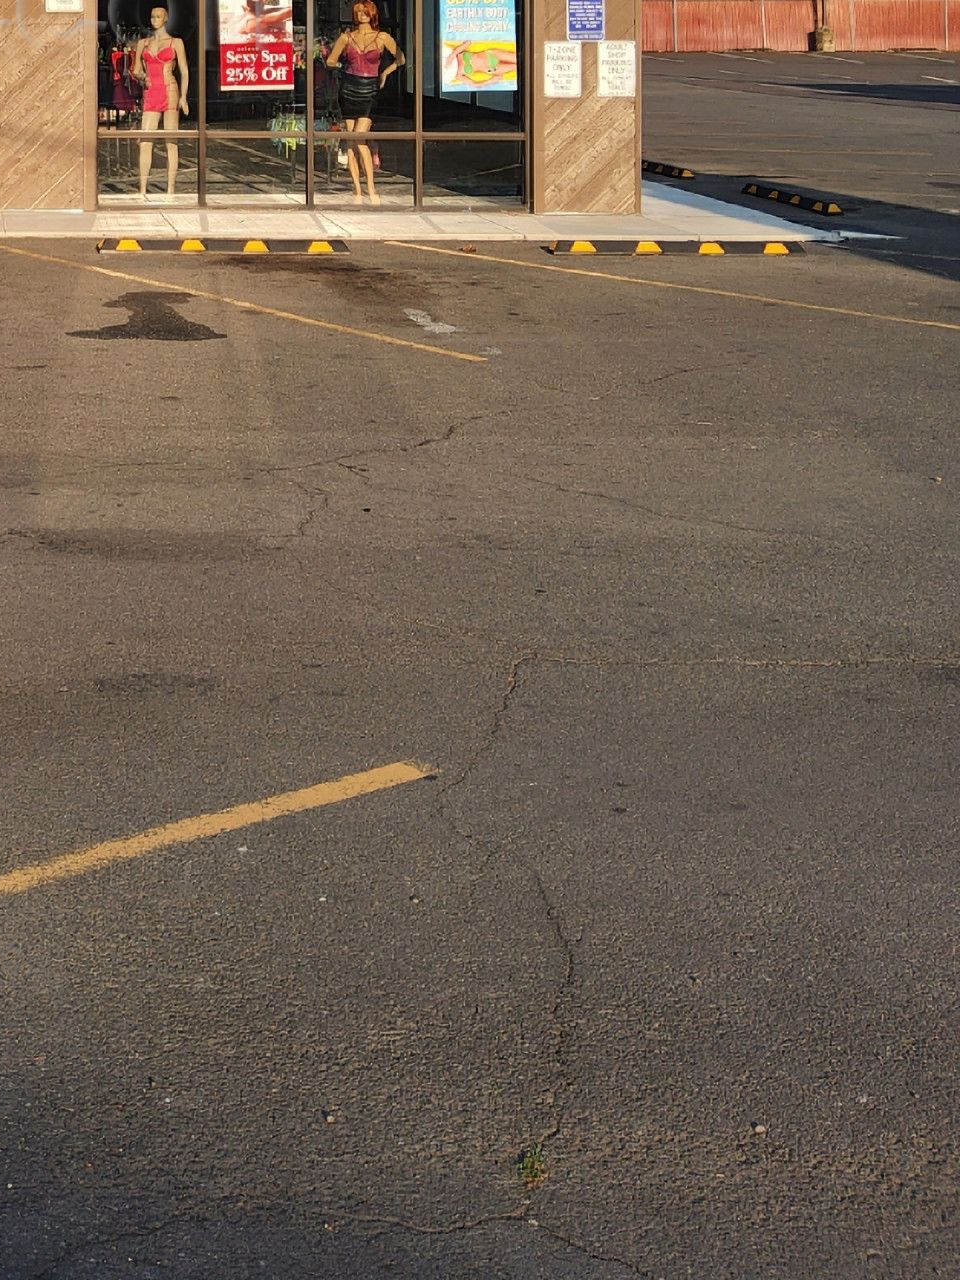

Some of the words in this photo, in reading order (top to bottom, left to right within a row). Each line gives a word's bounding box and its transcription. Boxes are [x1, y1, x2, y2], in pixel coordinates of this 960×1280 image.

[226, 50, 258, 67] Sexy
[261, 50, 287, 66] Spa
[226, 67, 258, 82] 25%
[262, 67, 289, 80] Off
